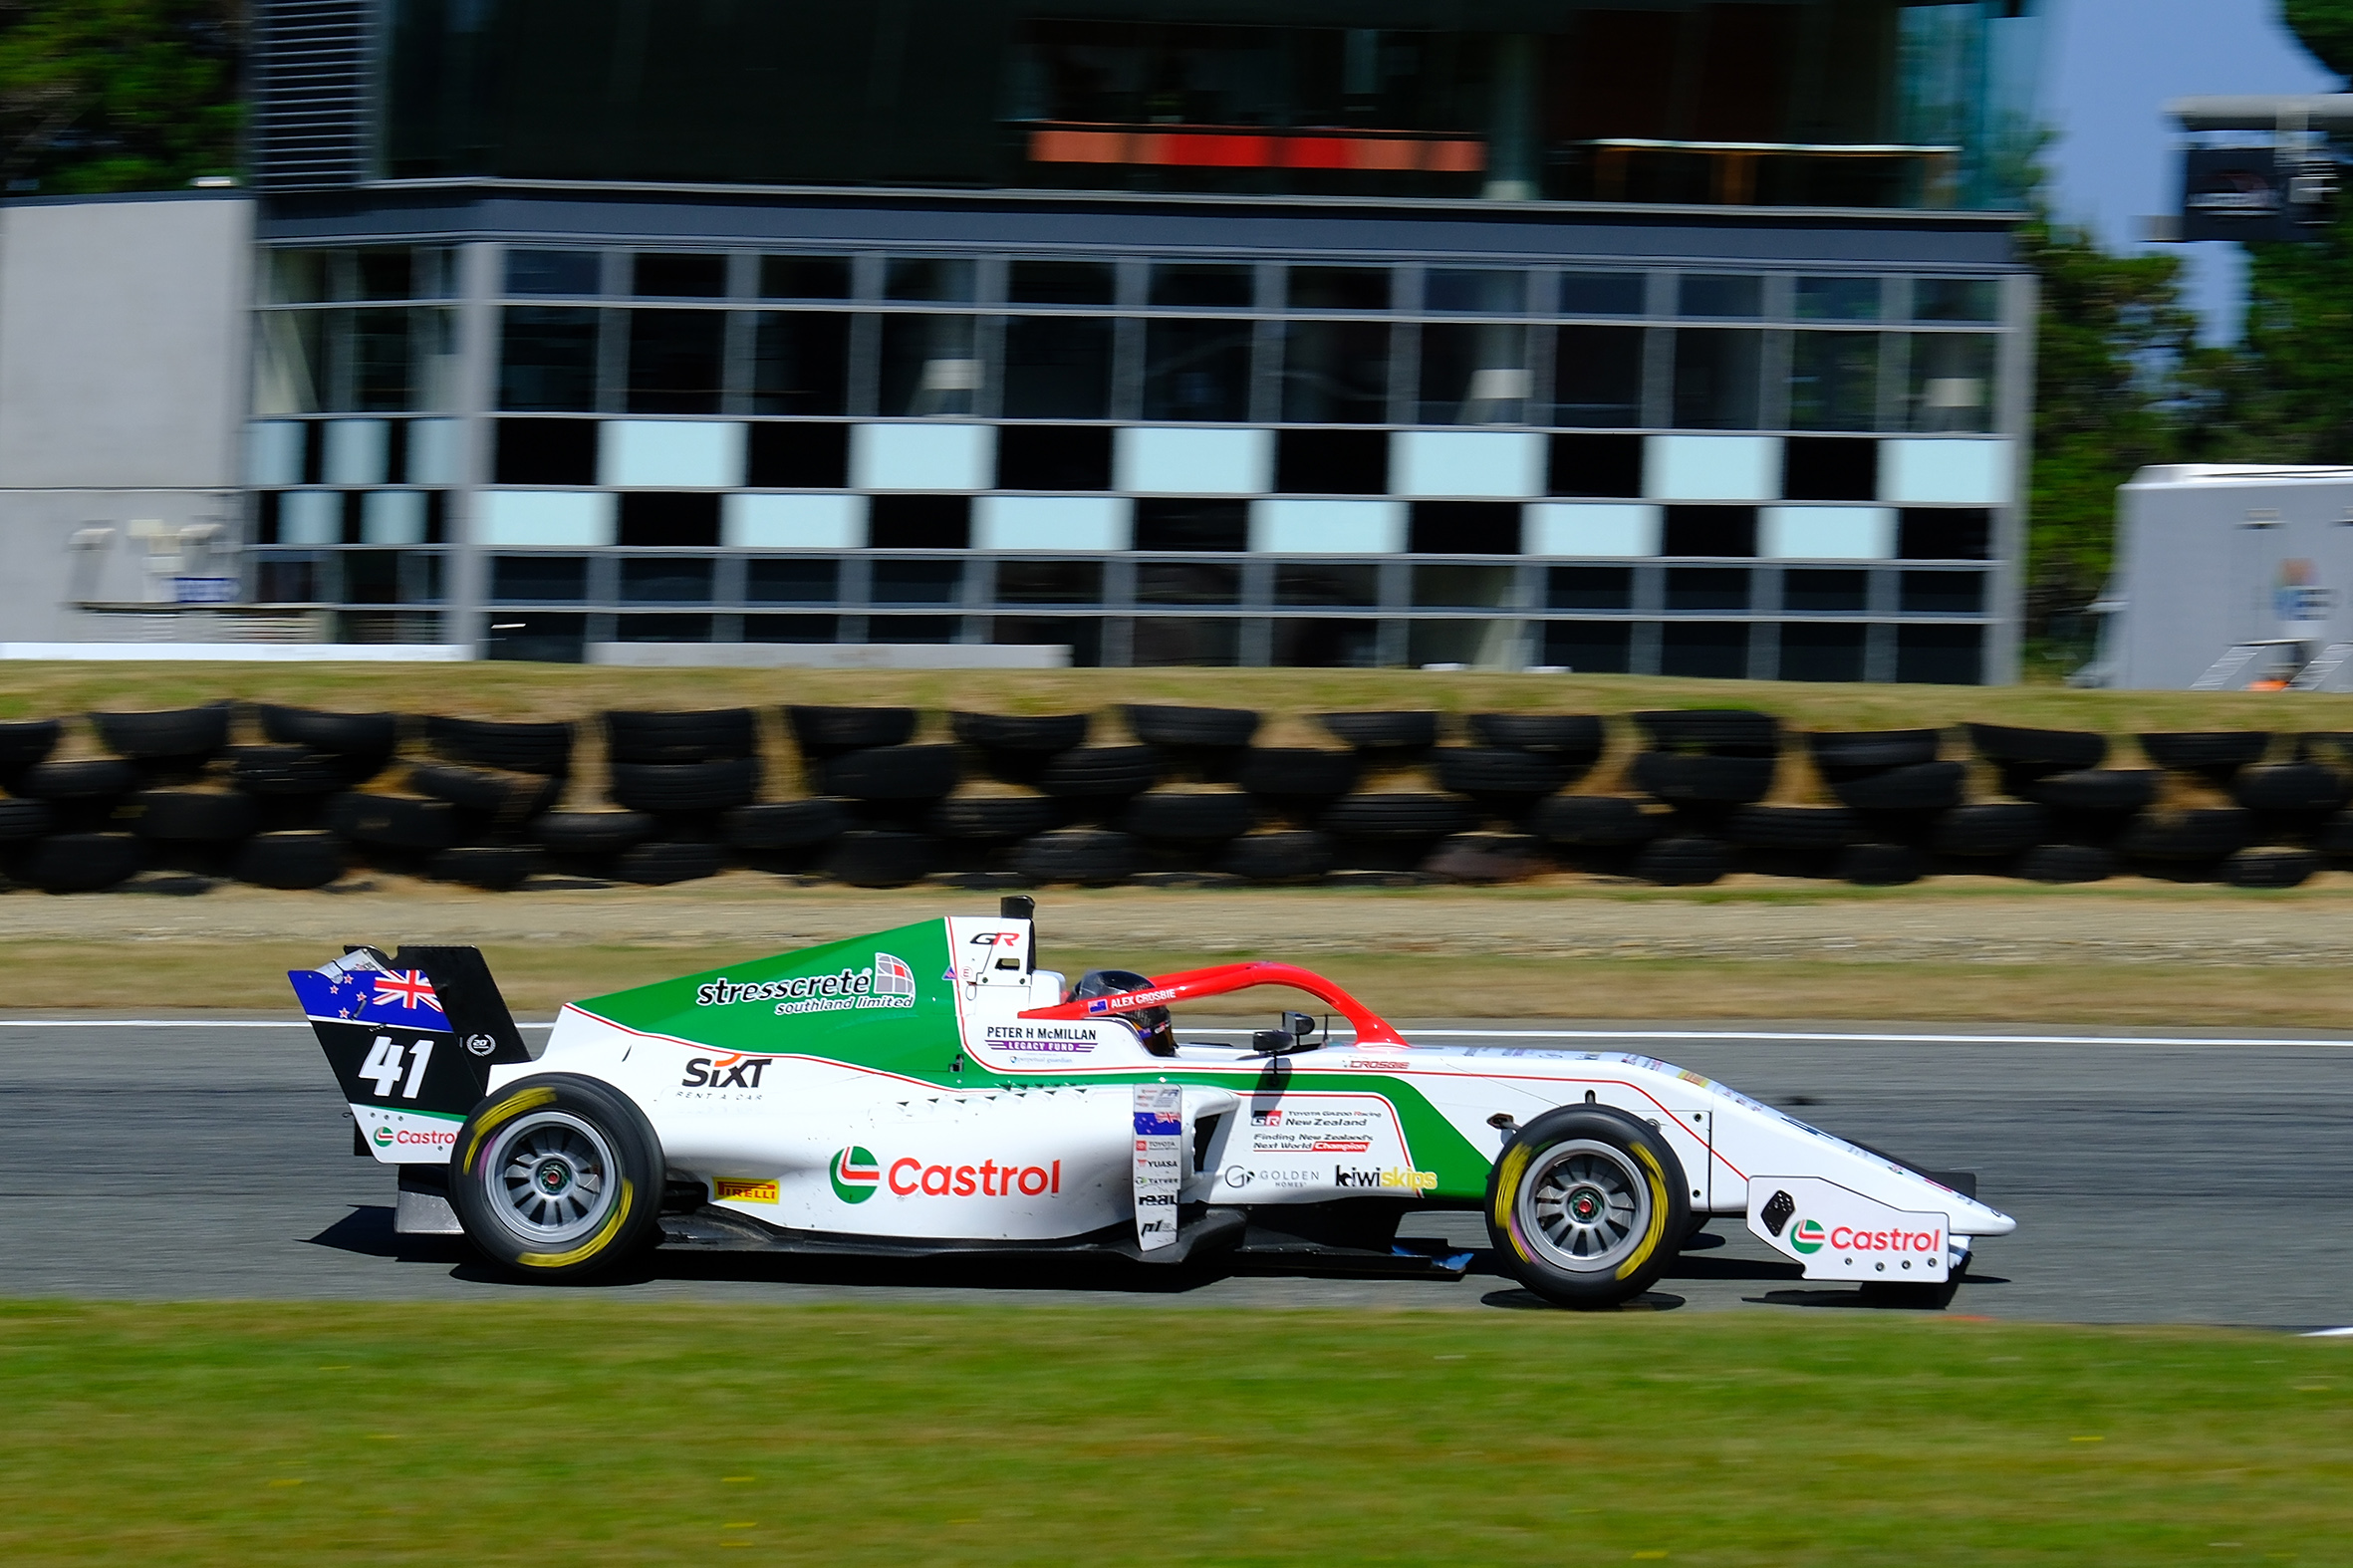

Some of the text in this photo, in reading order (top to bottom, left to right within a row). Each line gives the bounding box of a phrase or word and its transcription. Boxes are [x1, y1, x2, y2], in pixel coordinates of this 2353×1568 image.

[969, 932, 1020, 946] GR
[697, 968, 871, 1006] stresscrete
[775, 996, 915, 1015] southland limited
[1111, 989, 1176, 1008] ALEX CROSBIE
[987, 1026, 1097, 1040] PETER H McMILLAN
[1008, 1041, 1075, 1051] LEGACY FUND
[359, 1036, 434, 1099] 41
[1350, 1060, 1410, 1069] CROSBIE
[1313, 1118, 1368, 1127] Zealand
[396, 1130, 459, 1145] Castro
[1253, 1133, 1295, 1142] Finding
[1313, 1142, 1368, 1152] Champion
[889, 1157, 1061, 1196] Castrol
[1259, 1170, 1320, 1180] GOLDEN
[717, 1181, 776, 1199] PIRELLI
[1831, 1226, 1942, 1252] Castrol
